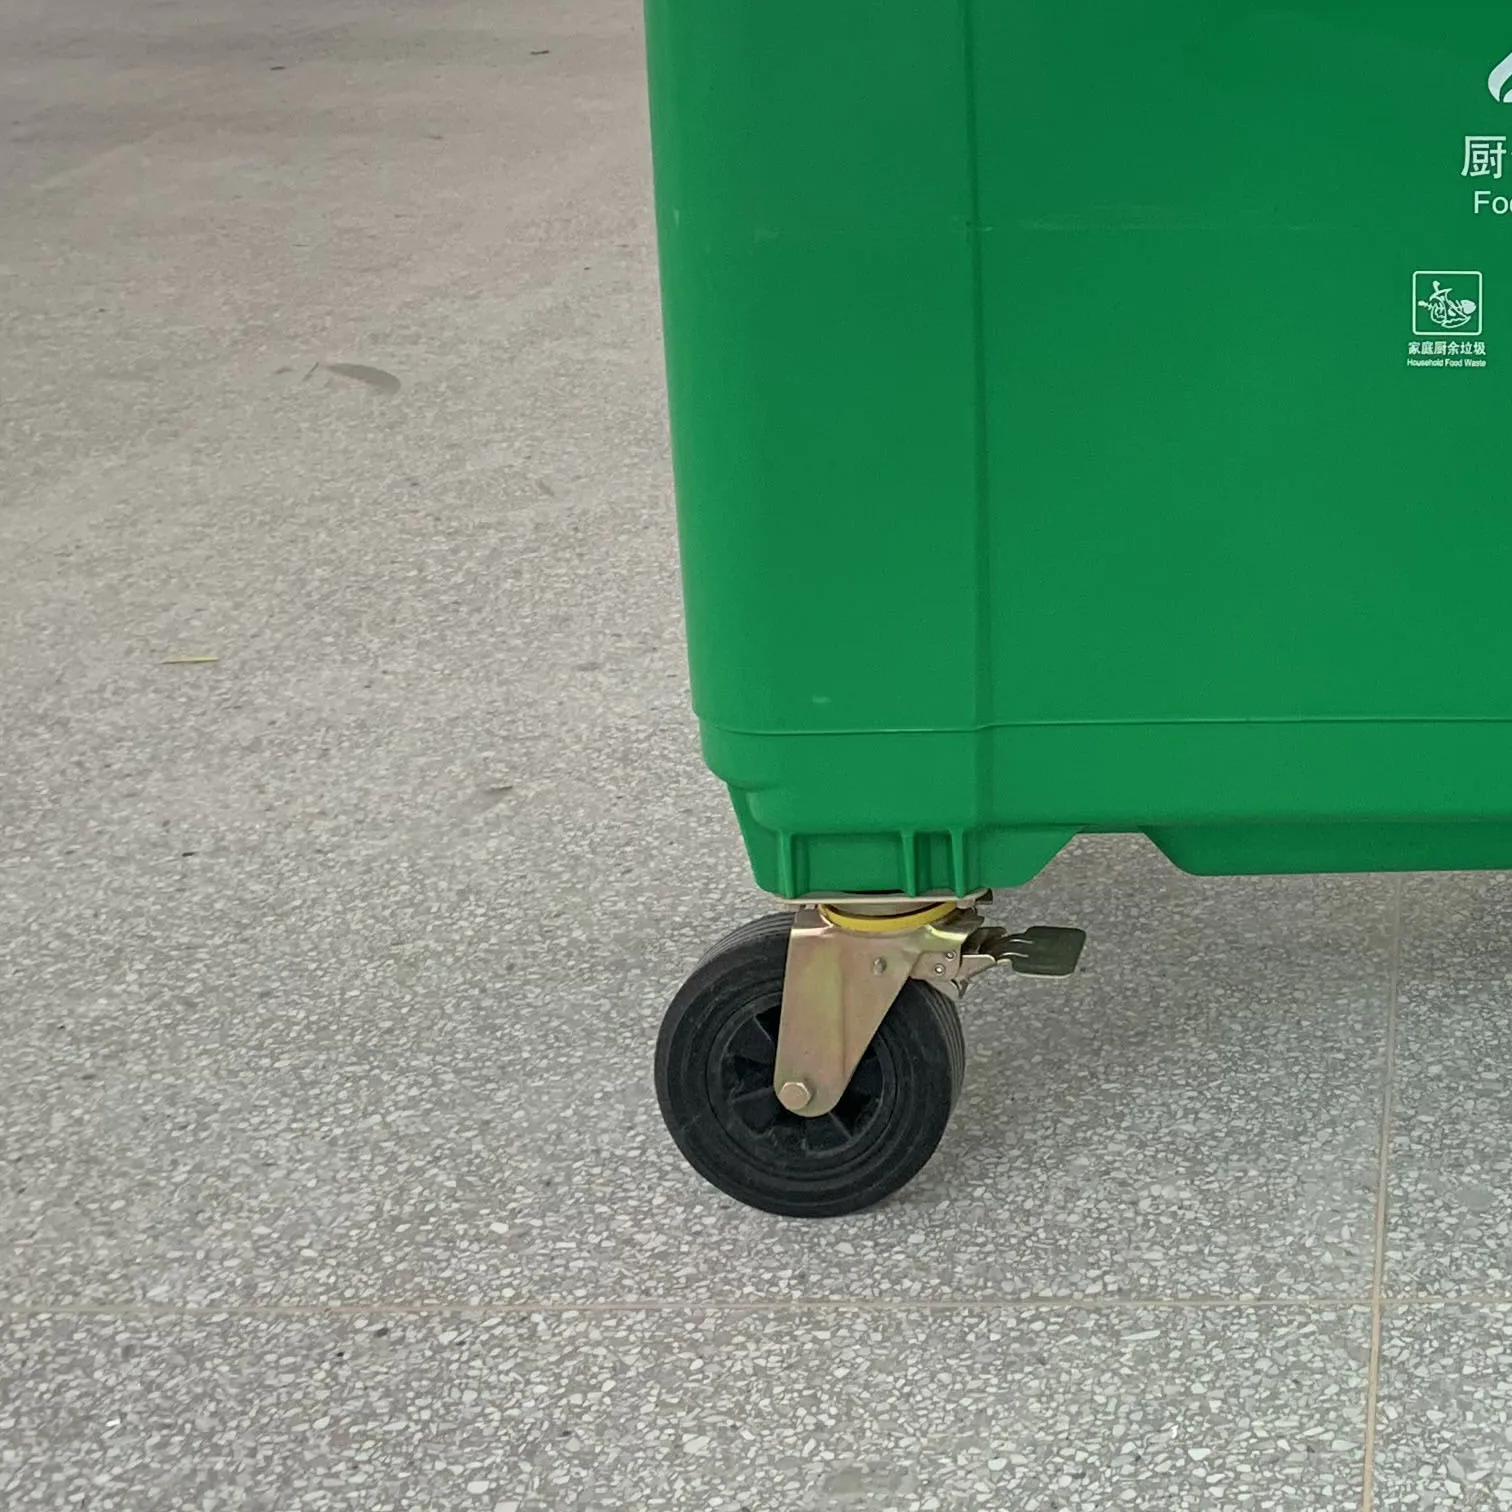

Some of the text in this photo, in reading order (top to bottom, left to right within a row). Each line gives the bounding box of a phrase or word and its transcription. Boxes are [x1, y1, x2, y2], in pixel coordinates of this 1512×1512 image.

[1408, 340, 1487, 355] 家庭厨余垃圾
[1406, 358, 1487, 367] Household Food Waste
